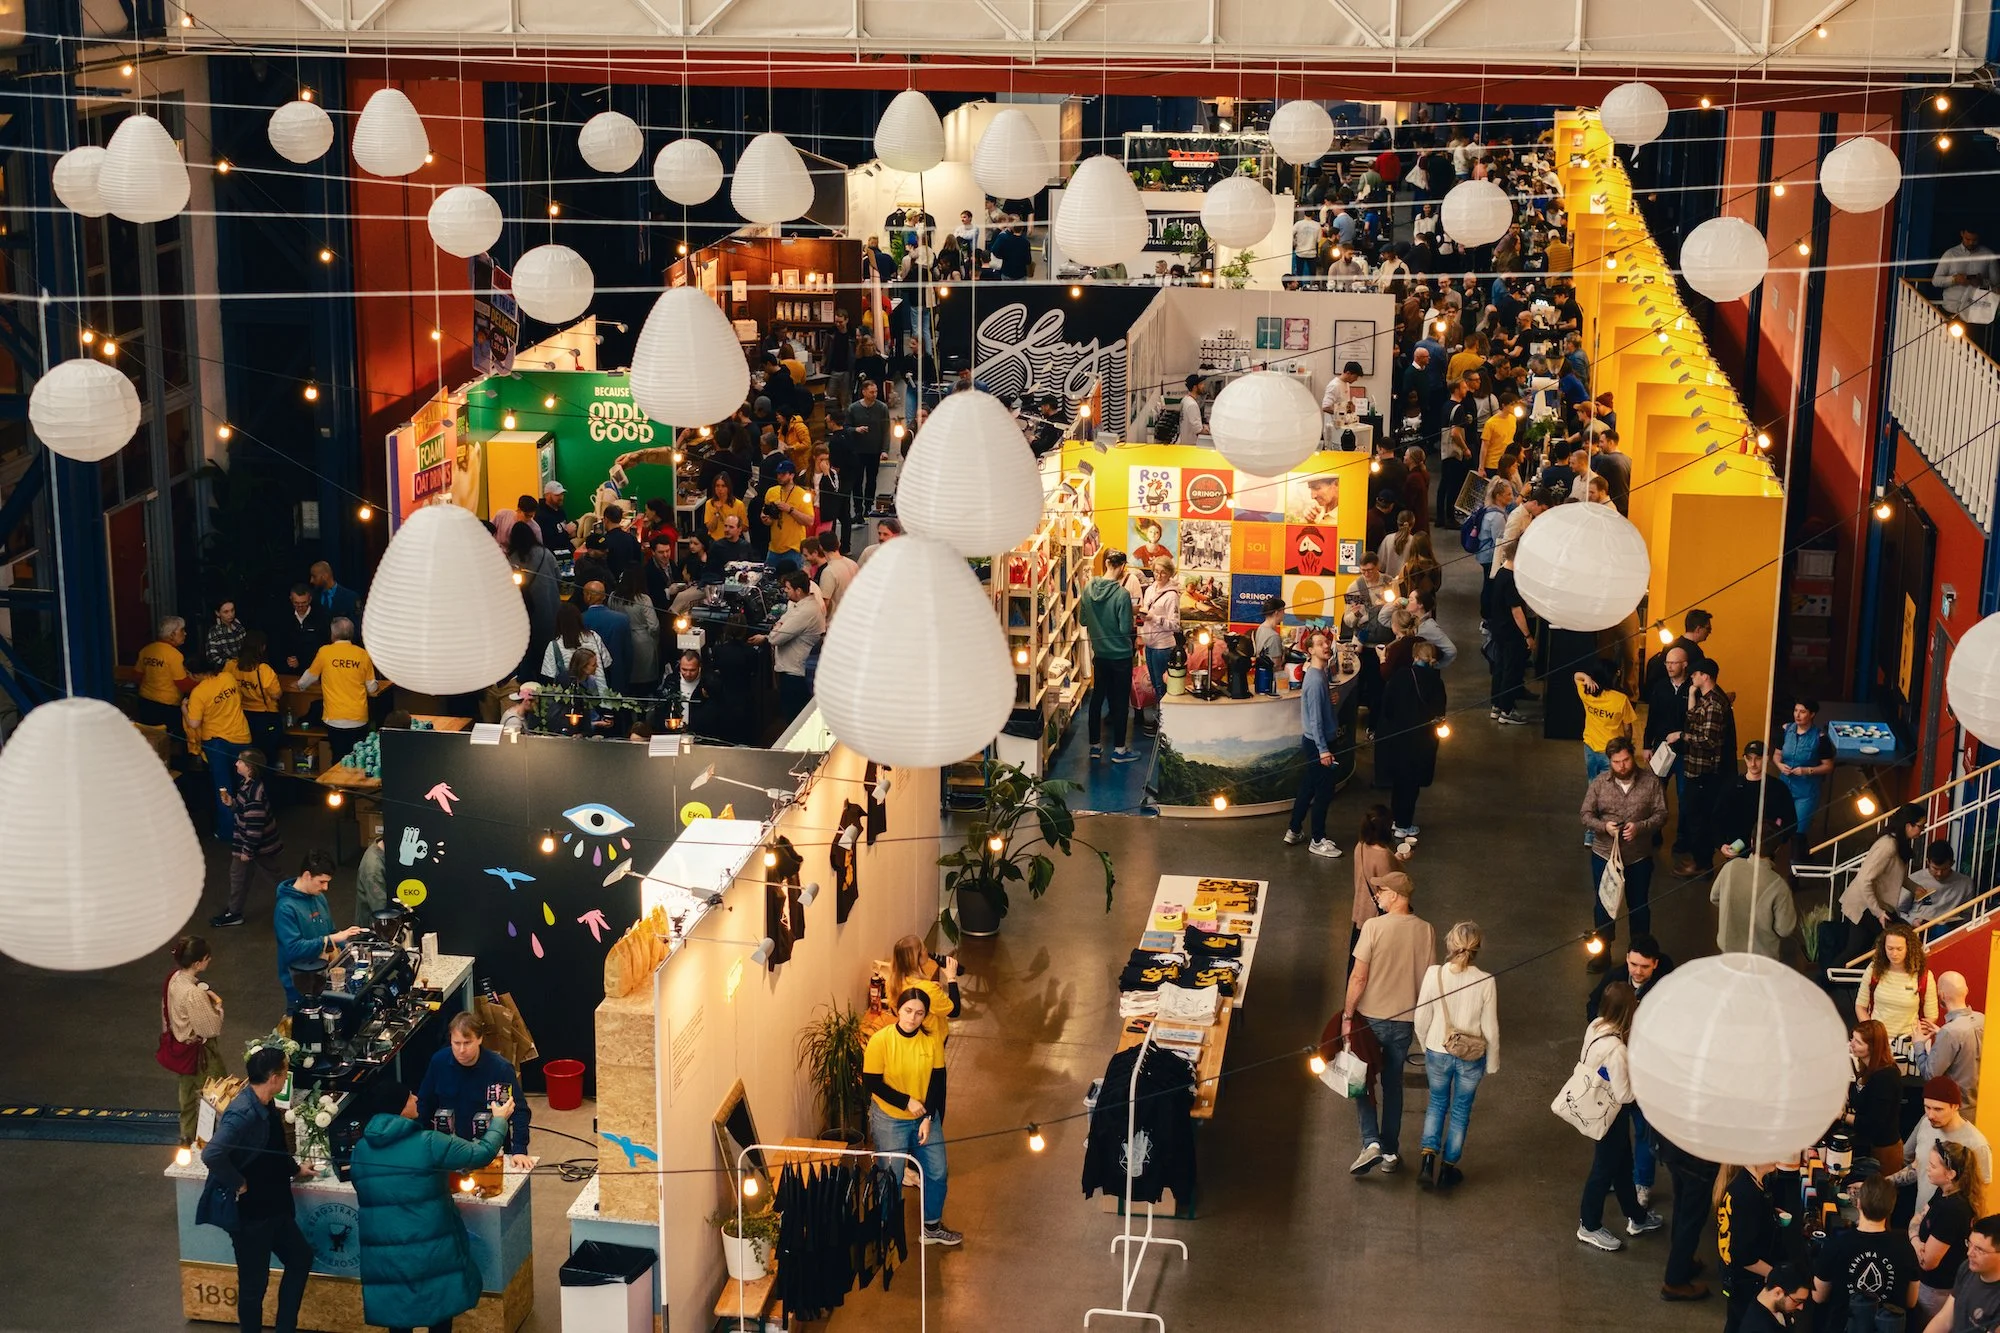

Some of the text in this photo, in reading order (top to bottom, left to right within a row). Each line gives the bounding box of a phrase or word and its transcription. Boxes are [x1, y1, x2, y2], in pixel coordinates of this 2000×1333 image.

[594, 386, 630, 397] BECAUSE
[588, 401, 648, 424] ODDLY
[590, 421, 654, 443] GOOD
[430, 463, 451, 490] DRINS
[1247, 542, 1268, 553] SOL
[1239, 592, 1272, 600] GRINGO
[143, 657, 164, 668] CREW
[332, 658, 361, 669] CREW
[214, 687, 236, 704] CREW
[1587, 705, 1614, 719] CREW
[688, 810, 705, 819] EKO
[403, 888, 420, 897] EKO
[1848, 1251, 1878, 1274] KAHIWA
